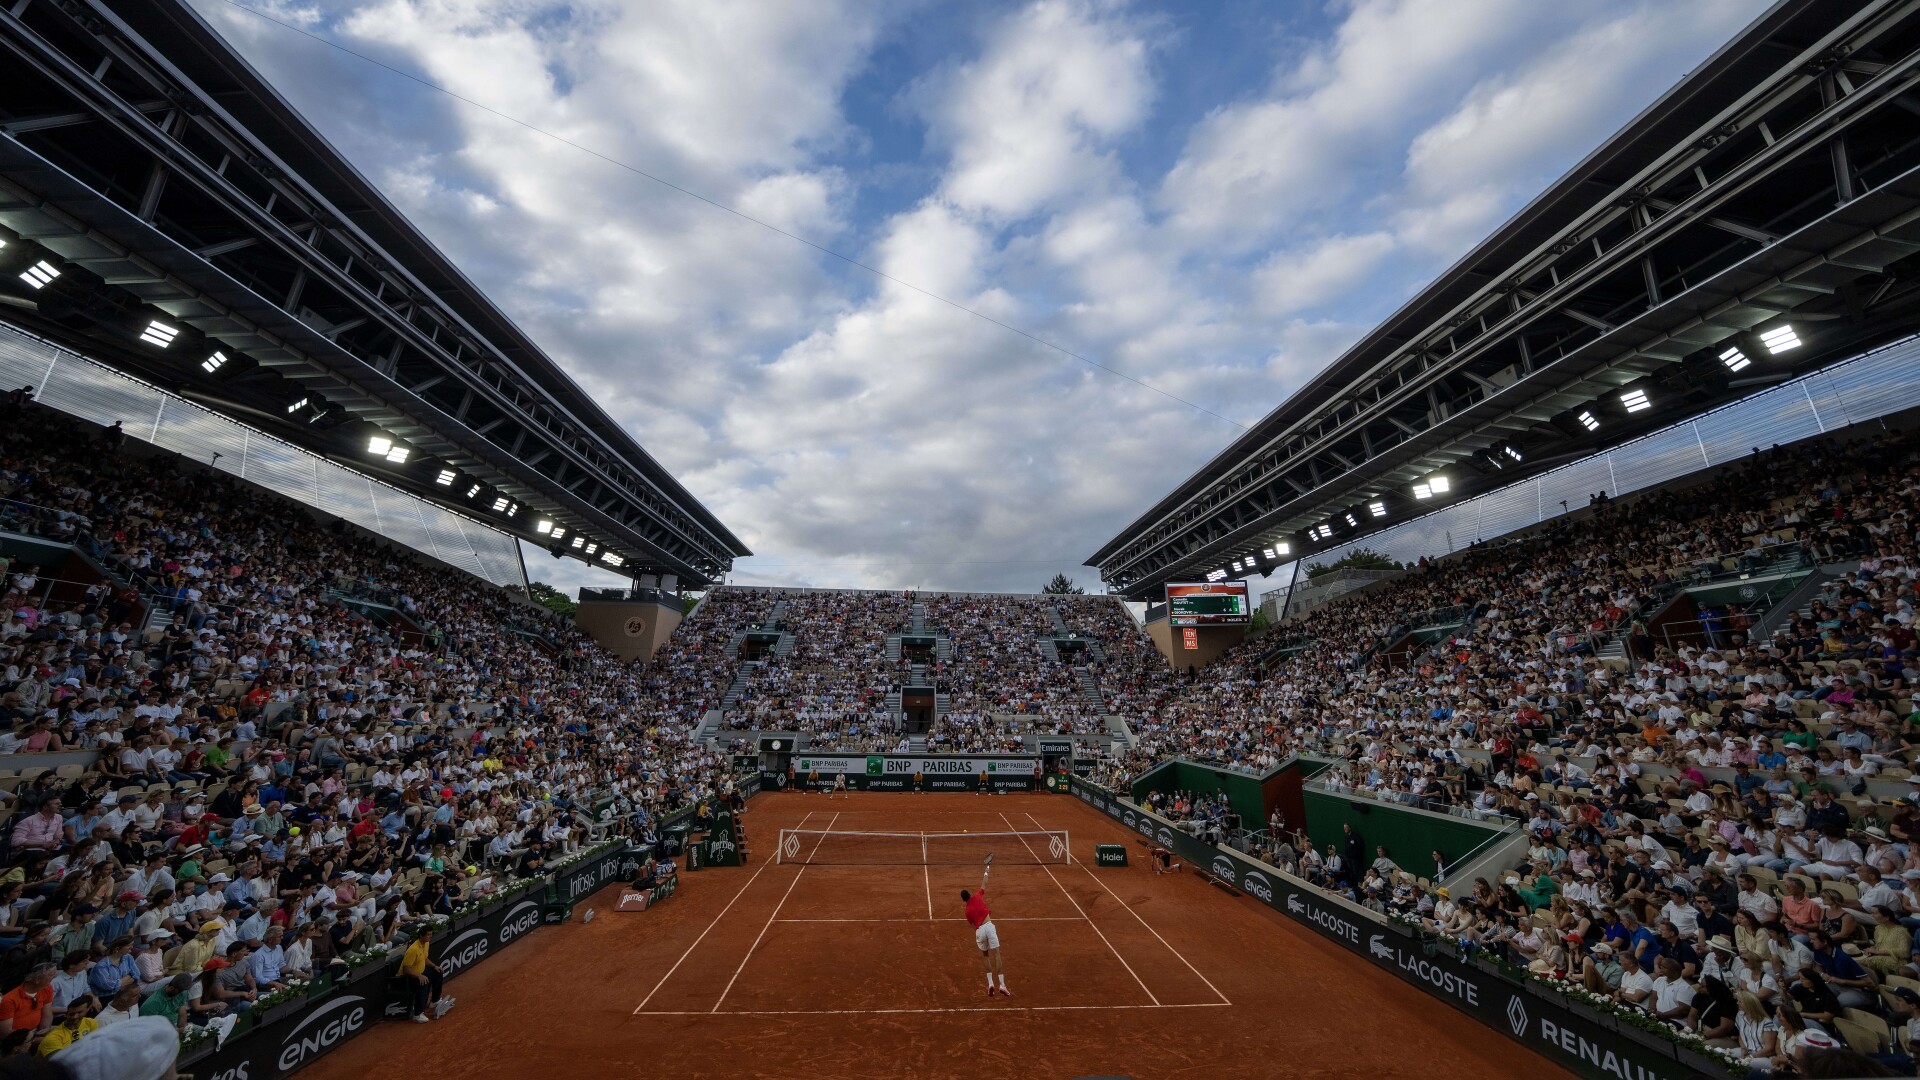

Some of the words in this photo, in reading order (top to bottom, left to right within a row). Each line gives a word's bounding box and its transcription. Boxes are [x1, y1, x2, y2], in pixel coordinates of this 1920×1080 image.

[1041, 744, 1070, 753] Emirates
[733, 765, 757, 773] ROLEX
[887, 761, 912, 773] BNP
[923, 761, 972, 773] PARIBAS
[1102, 852, 1124, 862] Haier
[569, 870, 596, 898] Infosys
[1306, 903, 1360, 944] LACOSTE
[1398, 948, 1480, 1007] LACOSTE
[1541, 1018, 1668, 1080] RENAU
